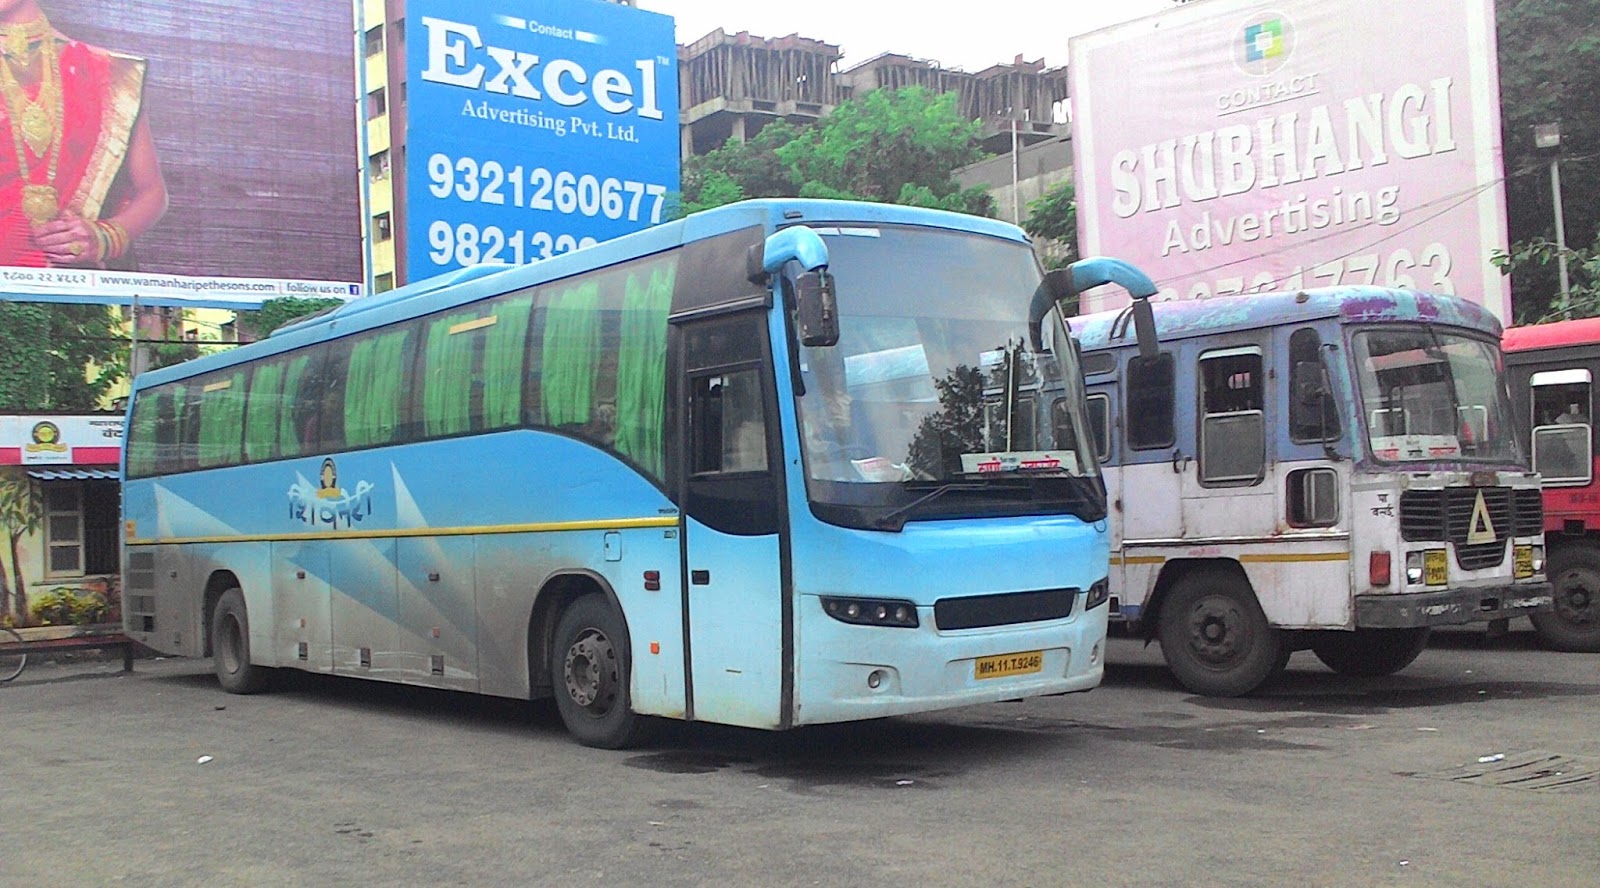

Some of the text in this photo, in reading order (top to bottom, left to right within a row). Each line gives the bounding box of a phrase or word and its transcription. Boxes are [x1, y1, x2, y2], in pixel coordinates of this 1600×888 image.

[528, 20, 574, 40] Contact
[421, 15, 664, 120] Excel
[1217, 73, 1318, 110] CONTACT
[461, 100, 640, 144] Advertising Pvt. Ltd.
[1110, 76, 1457, 219] SHUBHANGI
[428, 153, 667, 224] 9321260677
[1161, 184, 1402, 257] Advertising
[100, 275, 276, 293] www.wamanharipethesons.com
[286, 282, 318, 293] follow
[320, 286, 332, 294] us
